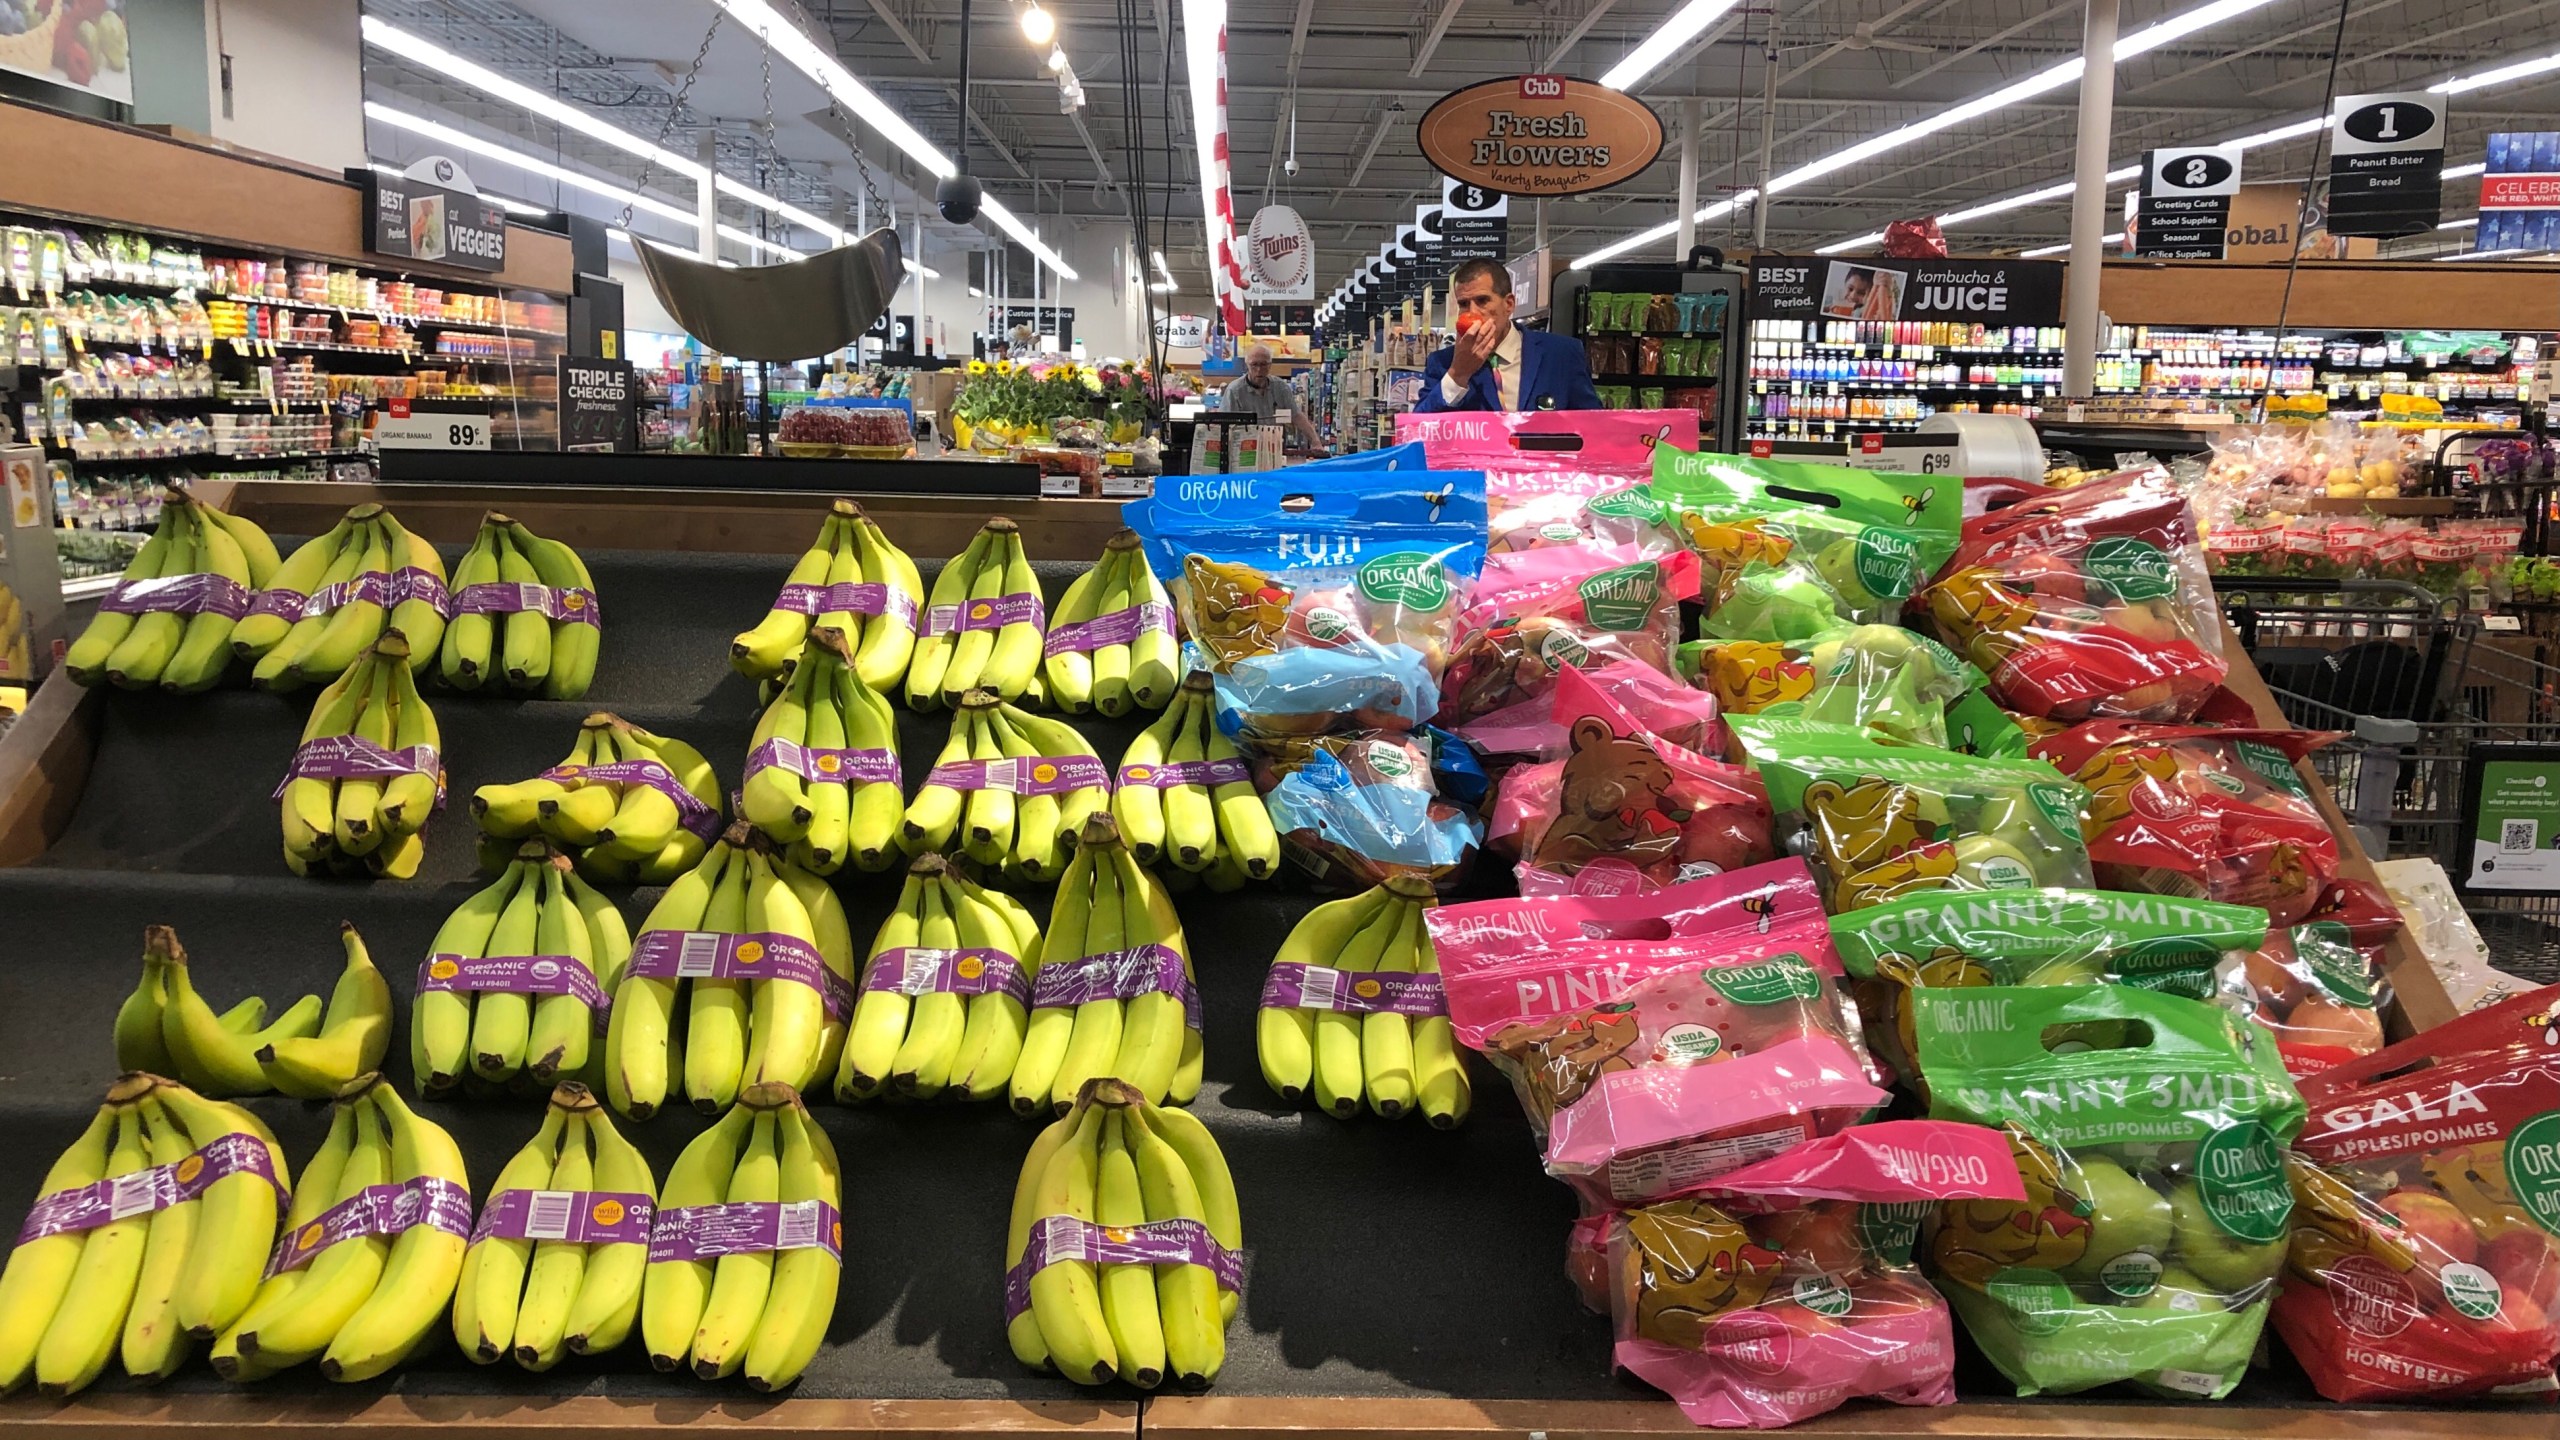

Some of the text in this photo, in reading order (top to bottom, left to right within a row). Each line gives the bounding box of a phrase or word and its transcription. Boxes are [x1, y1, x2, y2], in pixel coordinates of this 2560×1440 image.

[1524, 78, 1561, 96] Cub
[1489, 110, 1587, 137] Fresh
[2377, 107, 2398, 138] 1
[1471, 138, 1610, 166] Flowers
[2350, 155, 2424, 168] Peanut Butter
[2185, 158, 2208, 185] 2
[1491, 170, 1590, 190] Variety Bouquets
[2369, 176, 2402, 187] Bread
[381, 189, 404, 211] BEST
[1466, 186, 1483, 208] 3
[2155, 199, 2219, 210] Greeting Cards
[2489, 195, 2508, 203] THE
[2509, 195, 2530, 203] RED,
[2151, 216, 2218, 226] School Supplies
[449, 224, 503, 260] VEGGIES
[1464, 235, 1500, 244] Vegetables
[2162, 233, 2200, 242] Seasonal
[2227, 224, 2290, 246] obal
[1260, 234, 1299, 261] Twins
[1469, 250, 1497, 258] Dressing
[2175, 250, 2211, 259] Supplies
[1758, 267, 1809, 283] BEST
[1916, 269, 2006, 284] kombucha &
[1759, 284, 1804, 296] produce
[1774, 295, 1815, 309] Period.
[1914, 287, 2008, 311] JUICE
[1007, 309, 1044, 319] Customr
[1155, 325, 1200, 336] Grab &
[568, 368, 625, 388] TRIPLE
[568, 386, 626, 401] CHECKED
[392, 404, 408, 412] Cub
[576, 400, 618, 412] freshness.
[381, 432, 432, 440] ORGANIC BANANAS
[1419, 421, 1490, 442] ORGANIC
[1179, 479, 1259, 502] ORGANIC
[1279, 534, 1361, 560] FUJI
[2231, 534, 2272, 547] Herbs
[2480, 535, 2509, 546] erbs
[2431, 544, 2474, 557] Herbs
[1366, 566, 1441, 593] ORGANIC
[780, 587, 826, 599] ORGANIC
[1591, 578, 1653, 603] ORGANIC
[1313, 611, 1340, 622] USDA
[1378, 747, 1403, 760] USDA
[1988, 867, 2019, 879] USDA
[1459, 908, 1556, 945] ORGANIC
[1869, 897, 2066, 945] GRANNY
[768, 941, 820, 969] ORGANIC
[464, 961, 526, 973] ORGANIC
[774, 954, 816, 974] BANANAS
[961, 962, 980, 972] wild
[776, 968, 812, 983] PLU #94011
[1385, 981, 1443, 992] ORGANIC
[1516, 961, 1632, 1016] PINK
[1390, 991, 1436, 1000] BANANAS
[1934, 998, 2016, 1033] ORGANIC
[1672, 1030, 1707, 1042] USDA
[1750, 1089, 1760, 1100] 2
[1763, 1085, 1781, 1097] LB
[2151, 1072, 2293, 1109] SMITH
[2323, 1081, 2488, 1132] GALA
[2333, 1121, 2499, 1158] APPLES/POMMES
[1879, 1144, 1988, 1185] ORGANIC
[598, 1206, 619, 1217] wild
[1140, 1220, 1200, 1232] ORGANIC
[1147, 1233, 1196, 1242] BANANAS
[2115, 1263, 2152, 1272] USDA
[1802, 1277, 1834, 1292] USDA
[2007, 1294, 2054, 1312] FIBER
[2345, 1289, 2399, 1323] FIBER
[2349, 1314, 2387, 1332] SOURCE
[1723, 1338, 1776, 1360] FIBER
[1881, 1355, 1889, 1366] 2
[1892, 1352, 1907, 1365] LB
[2347, 1348, 2465, 1383] HONEYBEAR
[2181, 1375, 2210, 1387] CHILE
